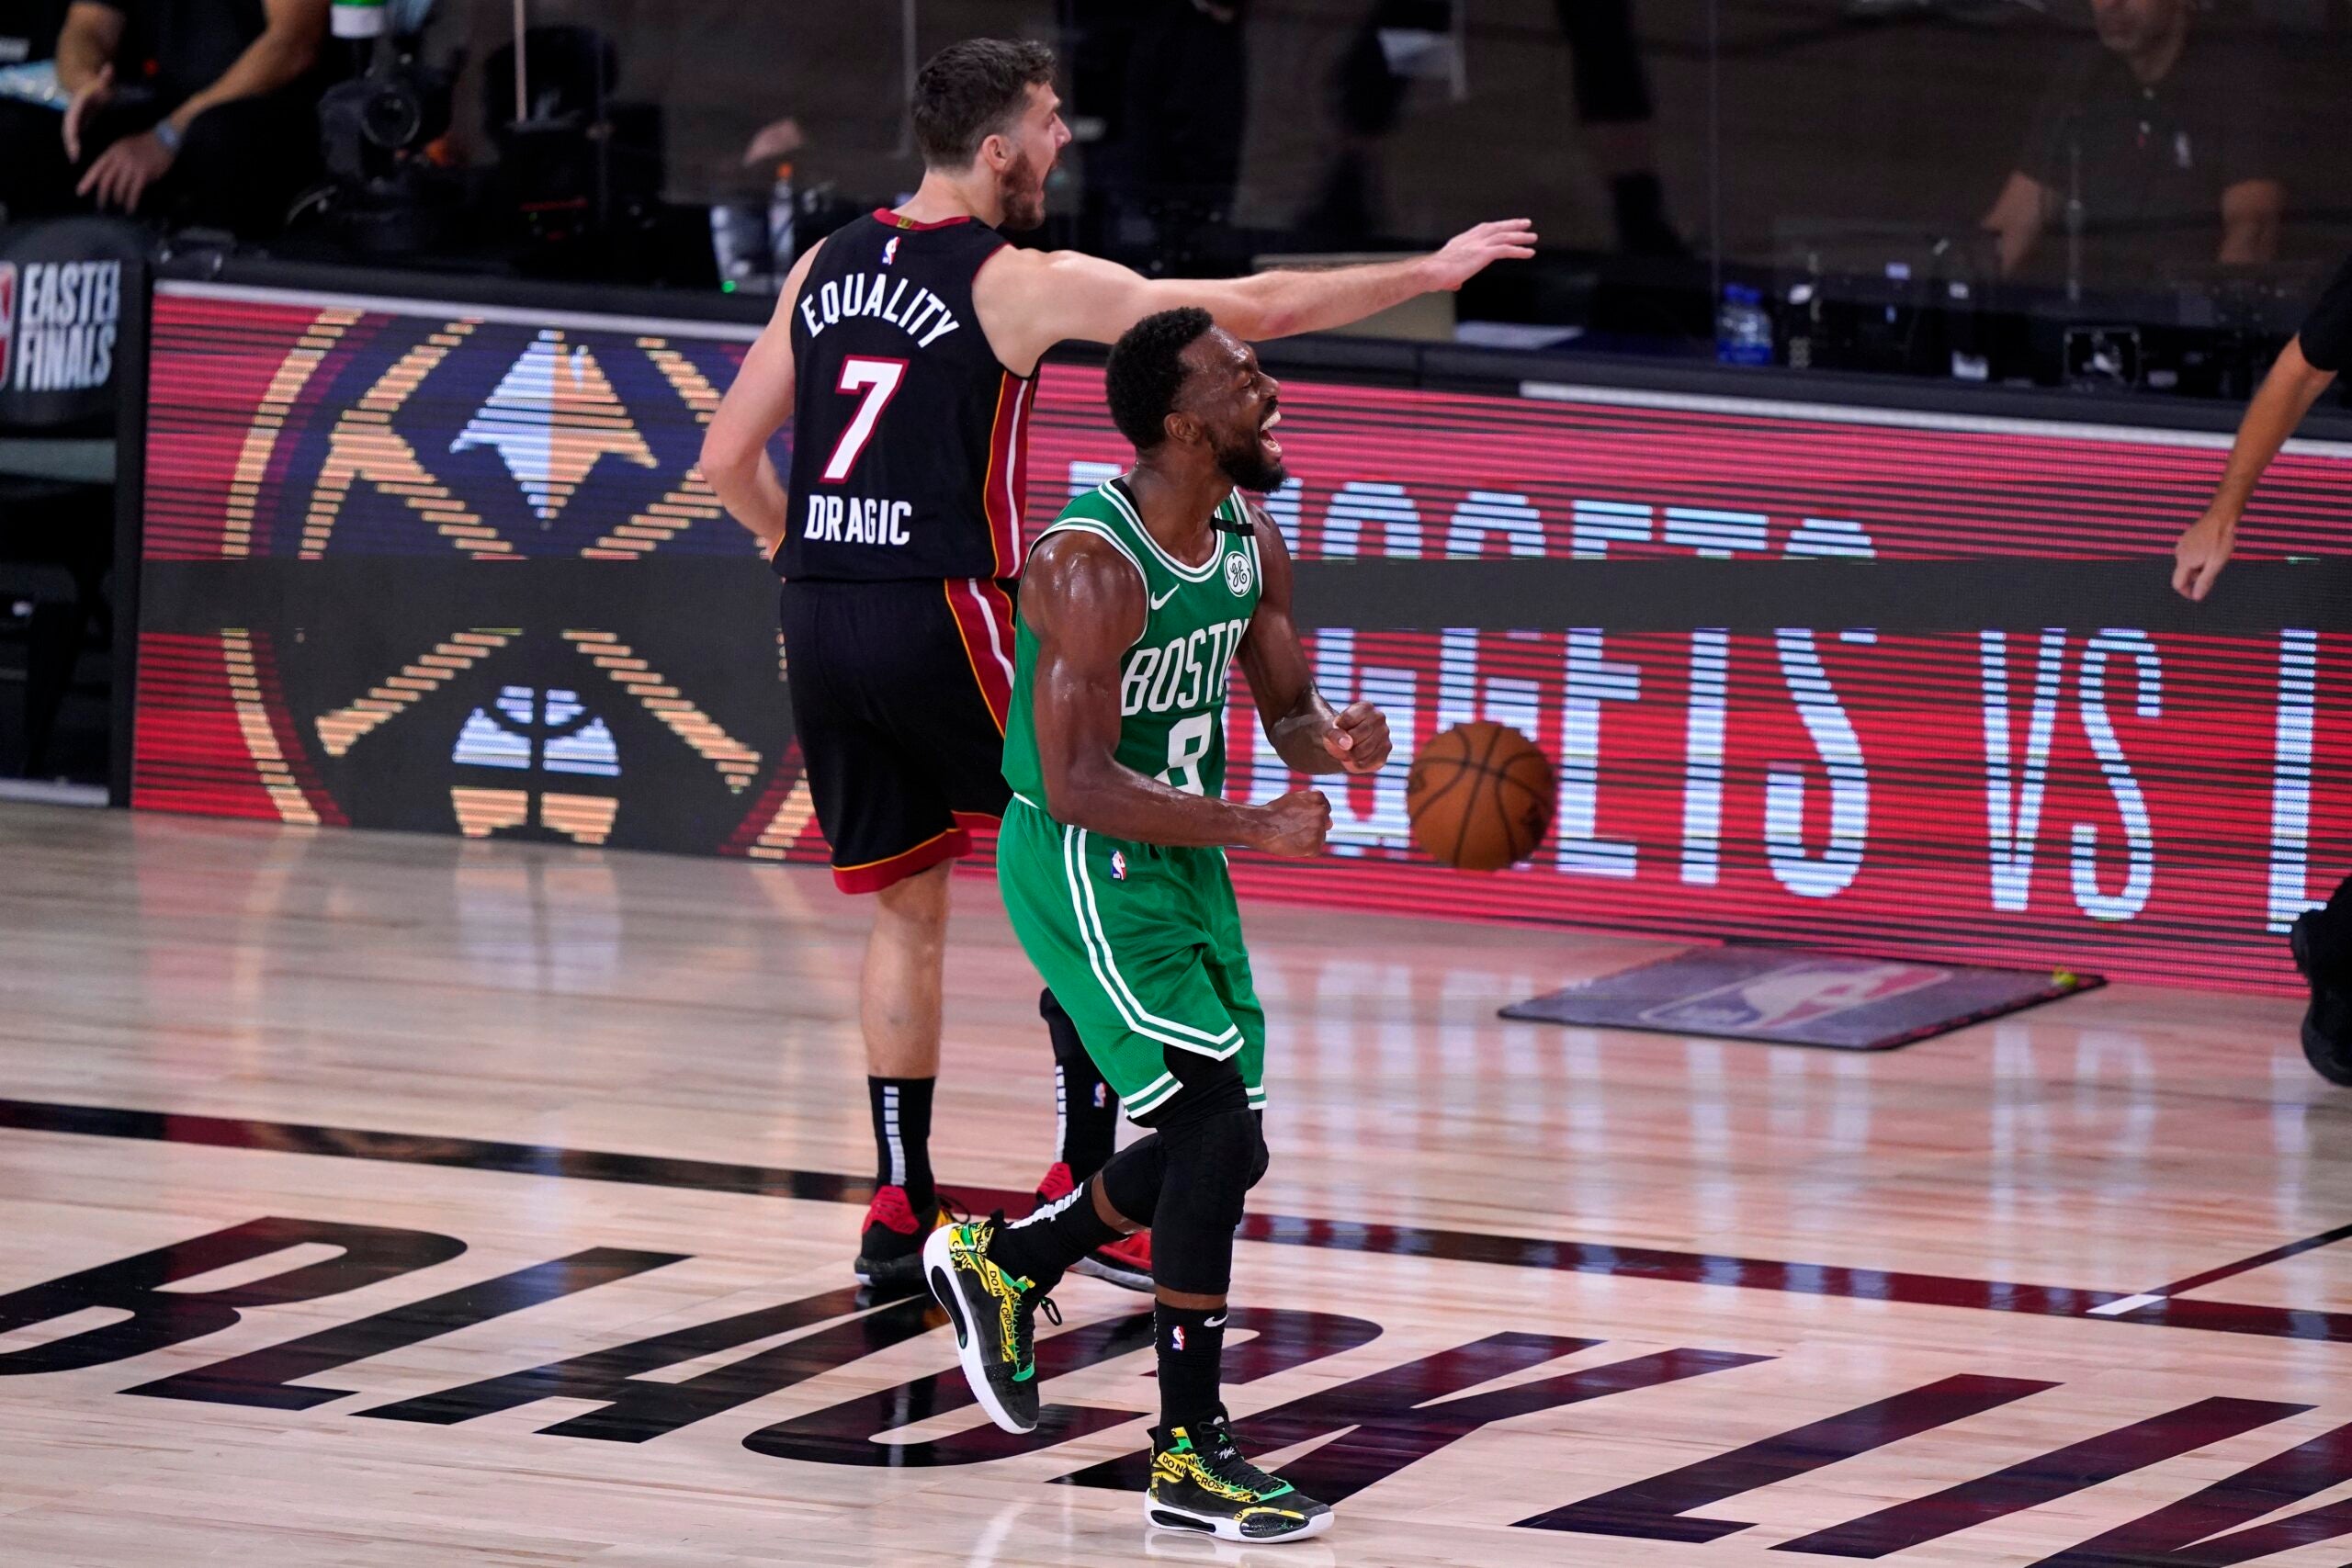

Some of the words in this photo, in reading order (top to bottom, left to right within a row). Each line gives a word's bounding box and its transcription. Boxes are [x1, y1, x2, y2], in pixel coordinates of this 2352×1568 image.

[22, 261, 121, 323] EASTE
[800, 273, 960, 348] EQUALITY
[15, 324, 116, 392] FINALS
[820, 355, 910, 485] 7
[804, 494, 912, 546] DRAGIC
[1120, 617, 1252, 717] BOSTO
[1981, 628, 2163, 921] VS
[1194, 1473, 1225, 1491] CROSS
